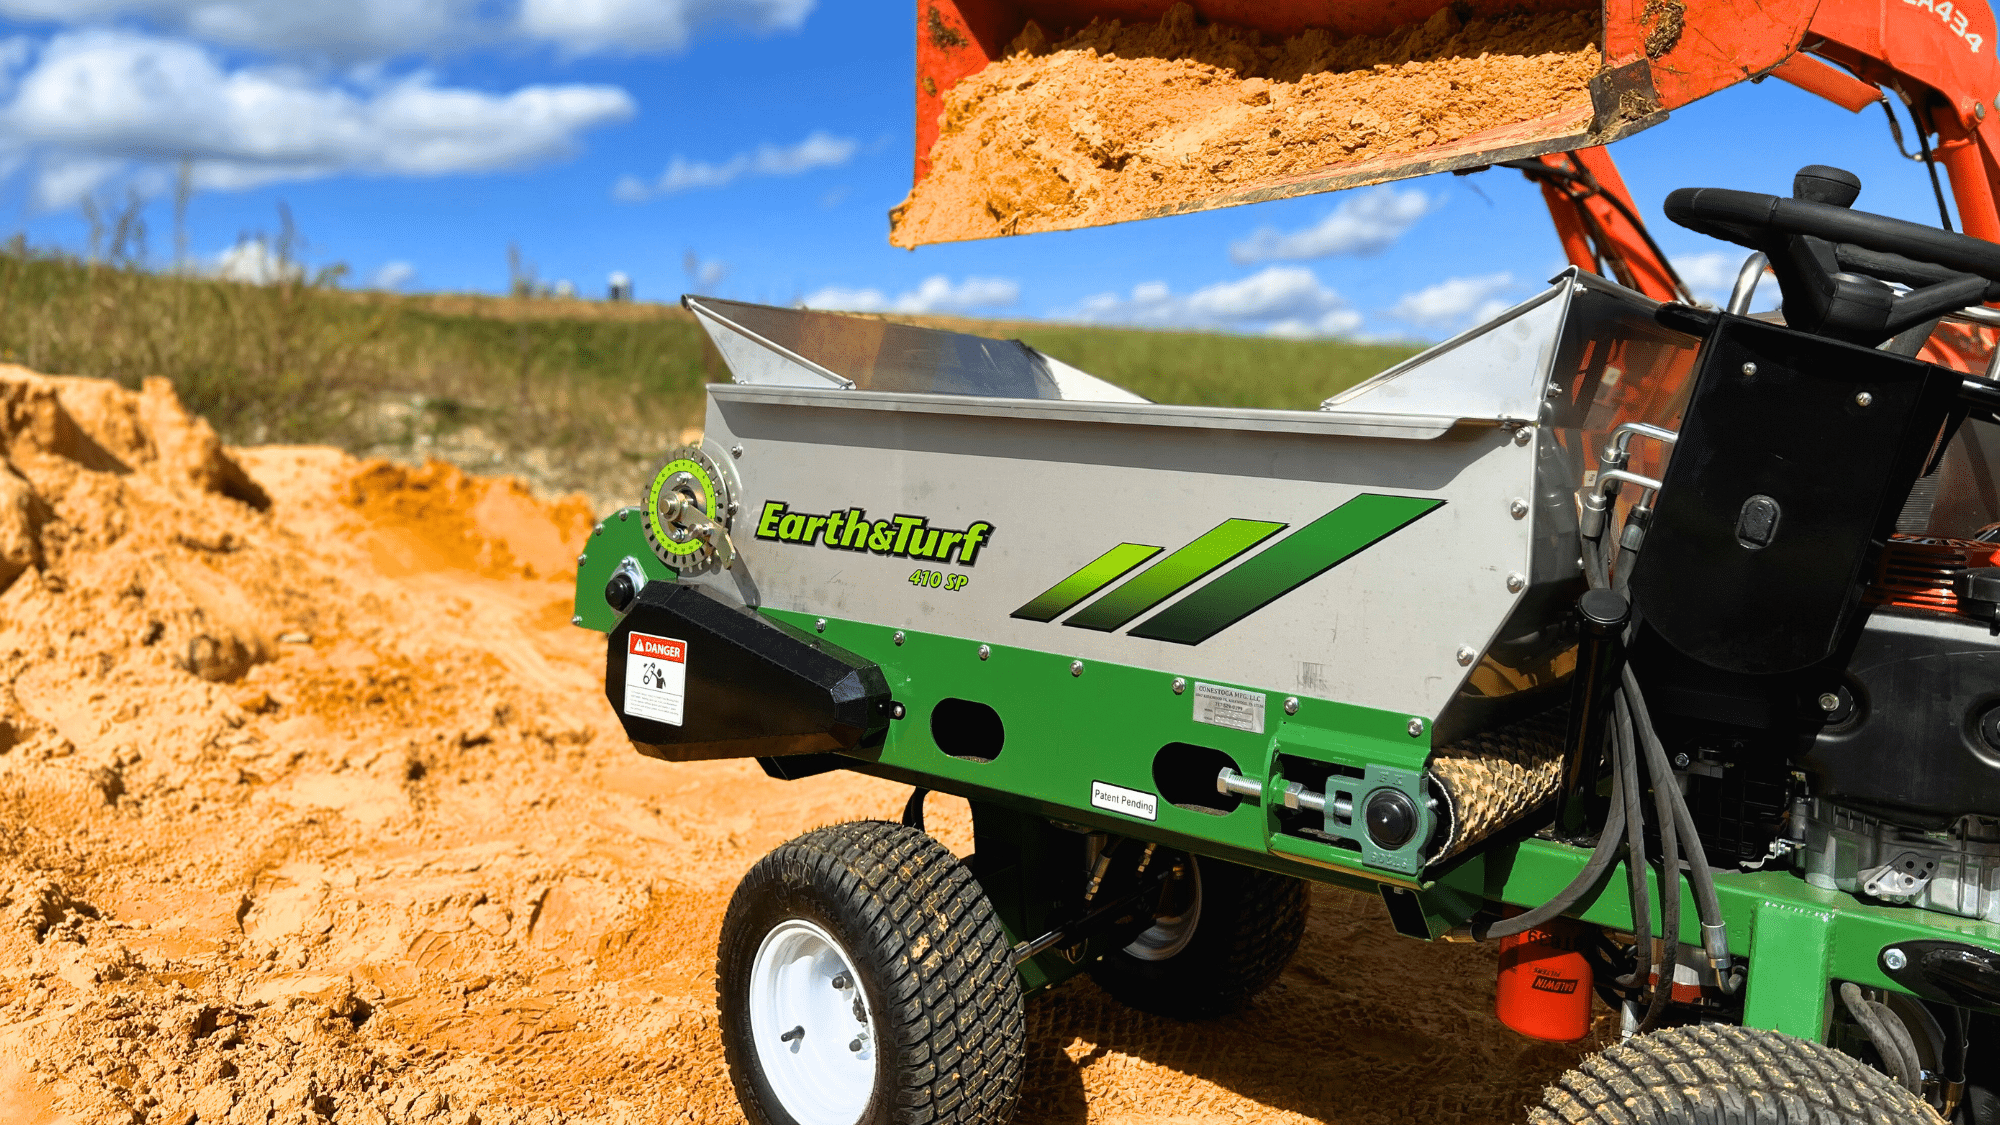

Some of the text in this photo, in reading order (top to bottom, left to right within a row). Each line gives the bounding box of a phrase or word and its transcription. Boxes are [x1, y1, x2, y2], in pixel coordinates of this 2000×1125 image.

[754, 499, 996, 567] Earth&Turf
[908, 569, 969, 592] 410 SP
[645, 641, 680, 658] DANGER
[1094, 788, 1153, 814] Patent Pending
[1533, 976, 1576, 993] BALDWIN
